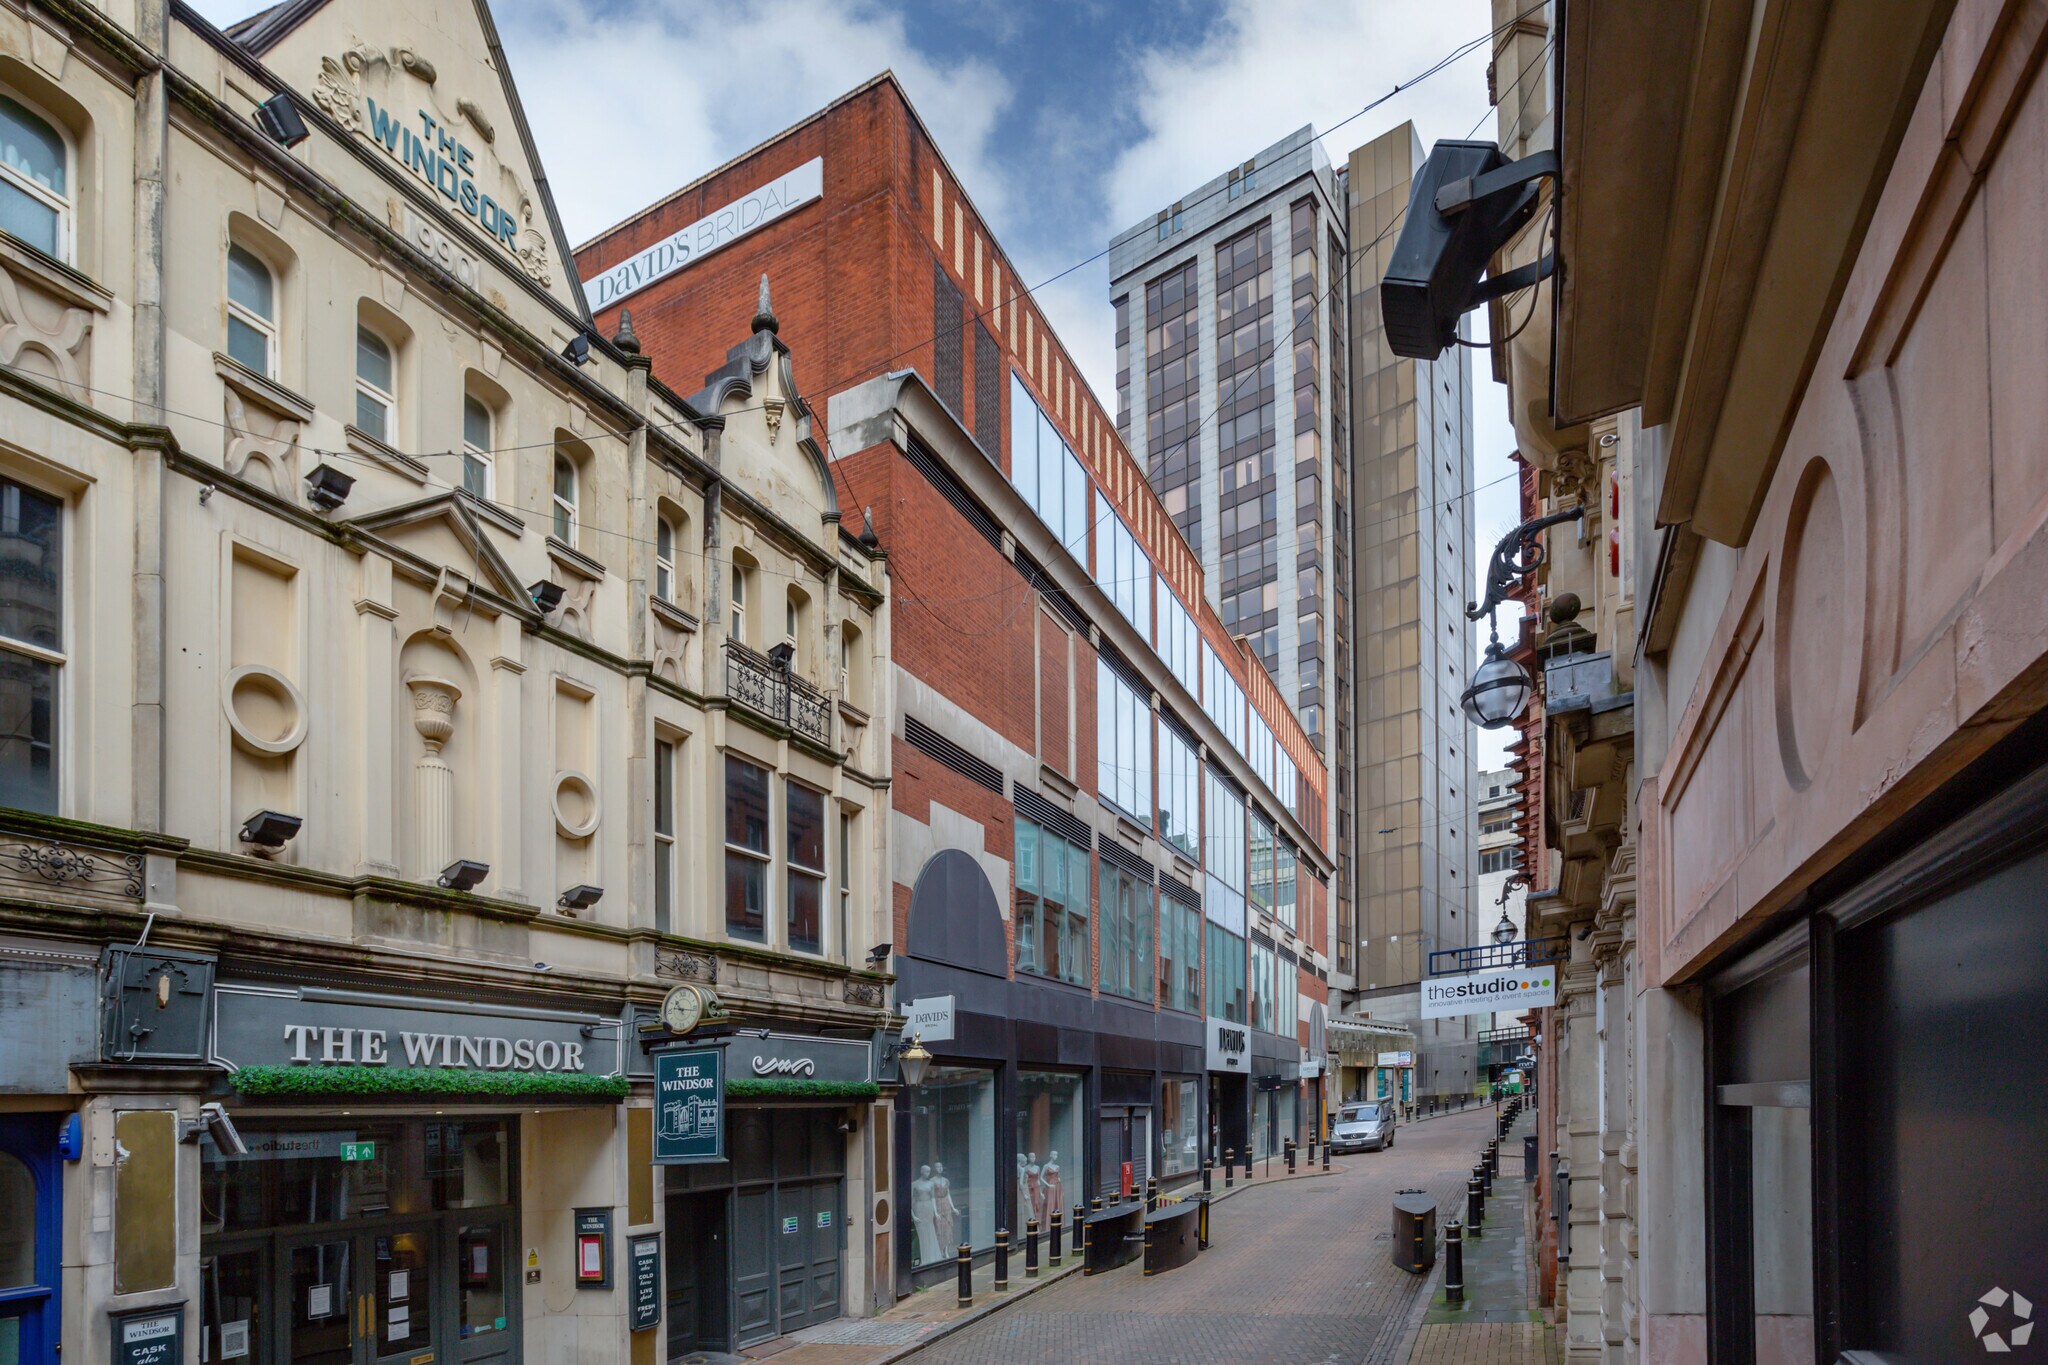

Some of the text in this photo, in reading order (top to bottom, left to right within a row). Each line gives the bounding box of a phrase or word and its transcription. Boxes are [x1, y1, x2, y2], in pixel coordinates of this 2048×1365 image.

[418, 109, 474, 176] THE
[367, 97, 517, 251] WINDSOR
[697, 181, 800, 253] BRIDAL
[408, 211, 475, 288] 1990
[1427, 977, 1518, 1001] thestudio
[1428, 999, 1463, 1008] innovative
[1464, 995, 1493, 1003] meeting
[1502, 992, 1521, 1000] event
[1522, 989, 1550, 998] spaces
[284, 1024, 585, 1071] THE WINDSOR
[676, 1066, 700, 1077] THE
[662, 1078, 714, 1092] WINDSOR
[640, 1287, 653, 1295] LIVE
[637, 1303, 656, 1312] FRESH
[129, 1326, 170, 1338] WINDSOR
[141, 1320, 159, 1330] THE
[132, 1344, 167, 1356] CASK
